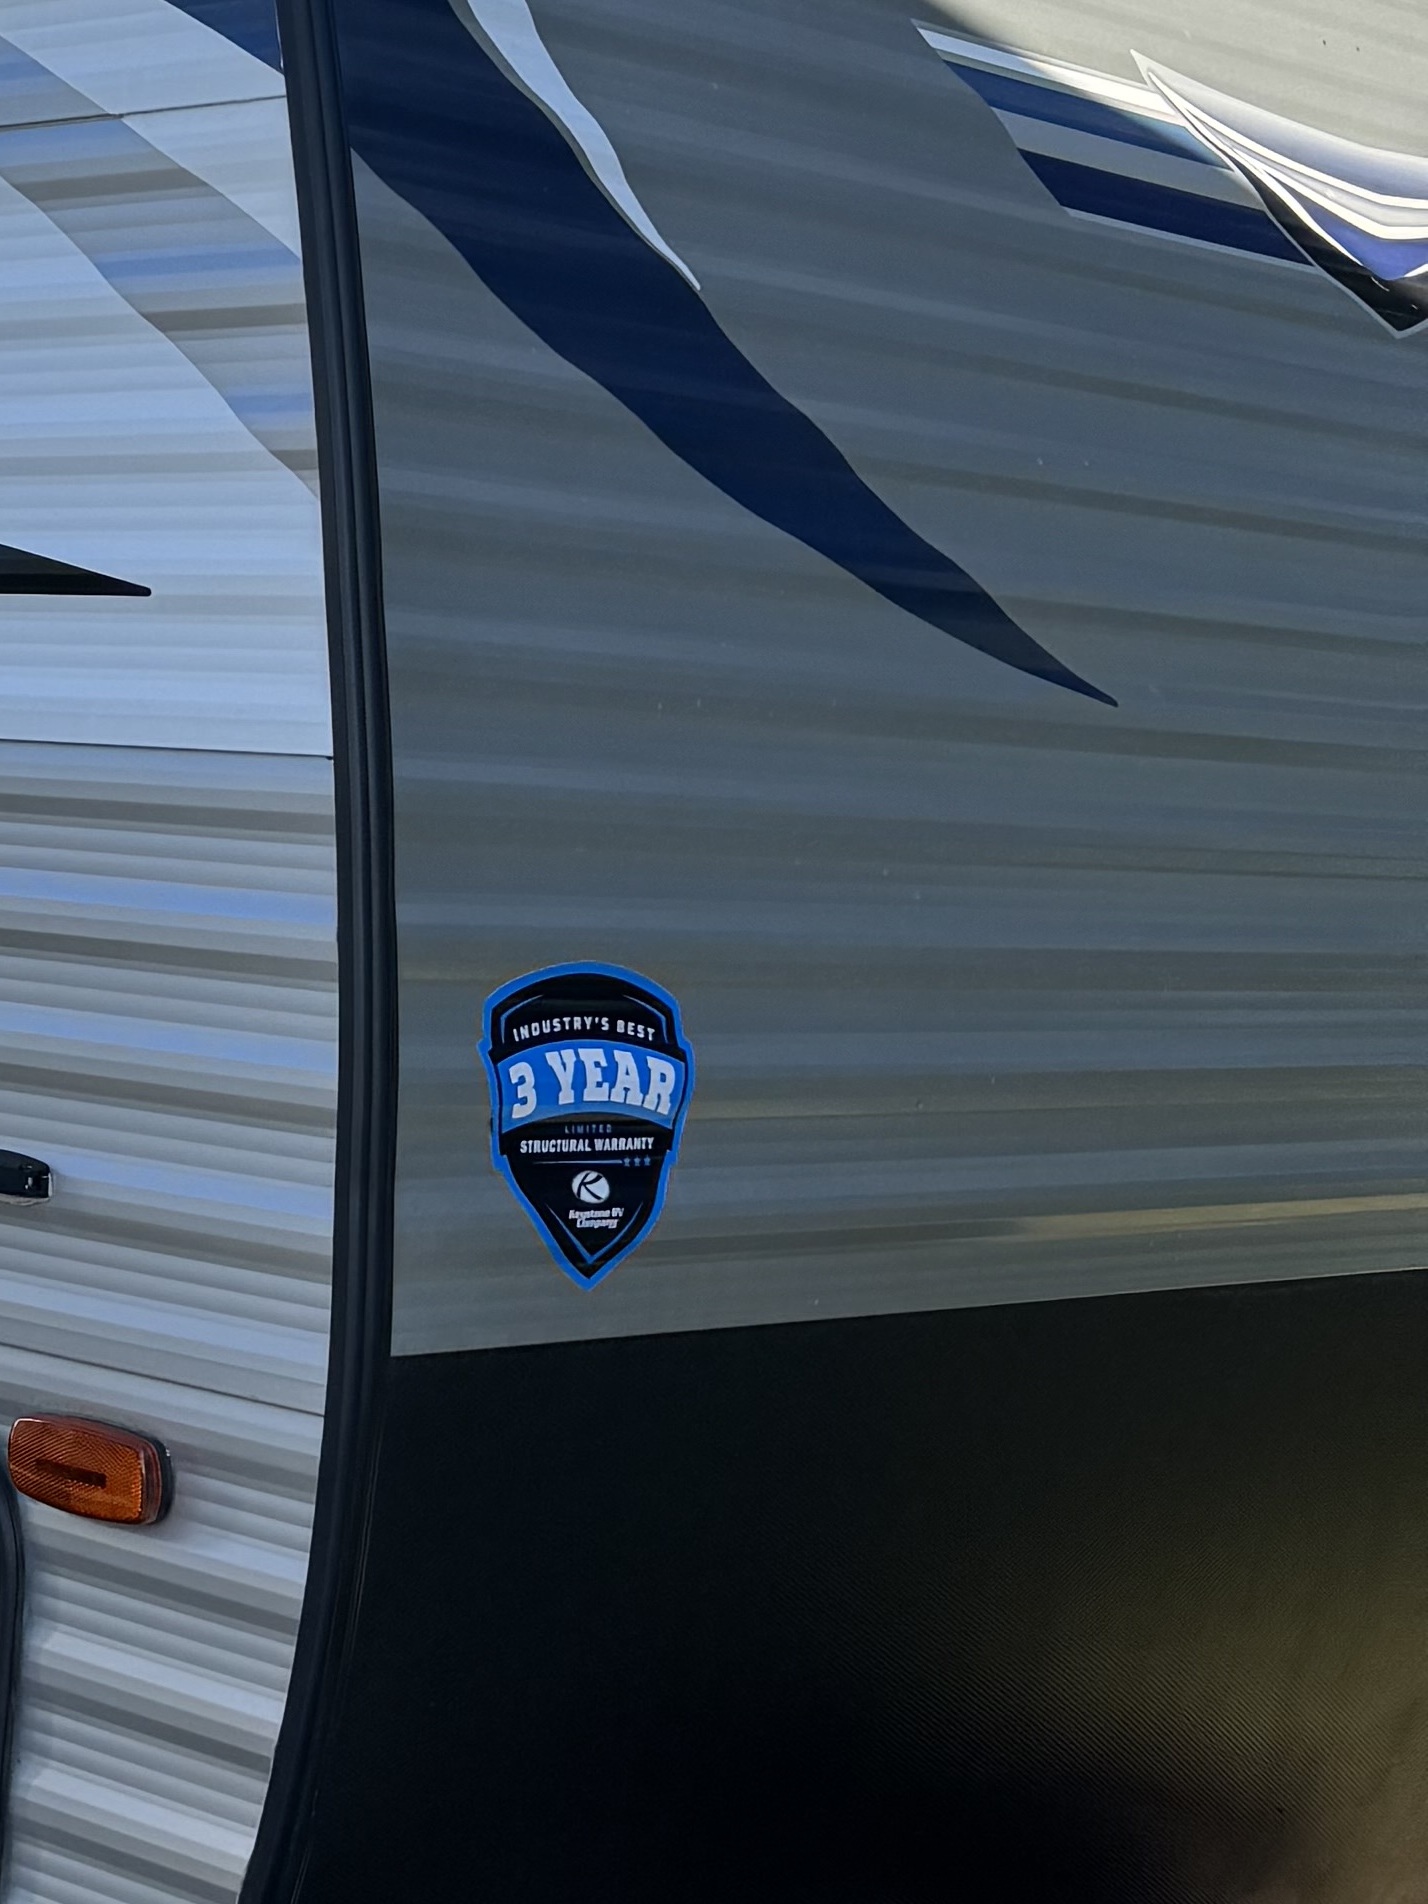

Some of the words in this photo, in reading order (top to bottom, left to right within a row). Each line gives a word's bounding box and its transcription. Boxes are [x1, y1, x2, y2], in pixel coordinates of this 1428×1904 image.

[512, 1016, 610, 1042] INDUSTRY'S
[616, 1019, 656, 1042] BEST
[508, 1061, 538, 1119] 3
[545, 1047, 676, 1116] YEAR
[564, 1123, 613, 1135] LIMITED
[519, 1138, 593, 1154] STRUCTURAL
[593, 1136, 655, 1152] WARRANTY
